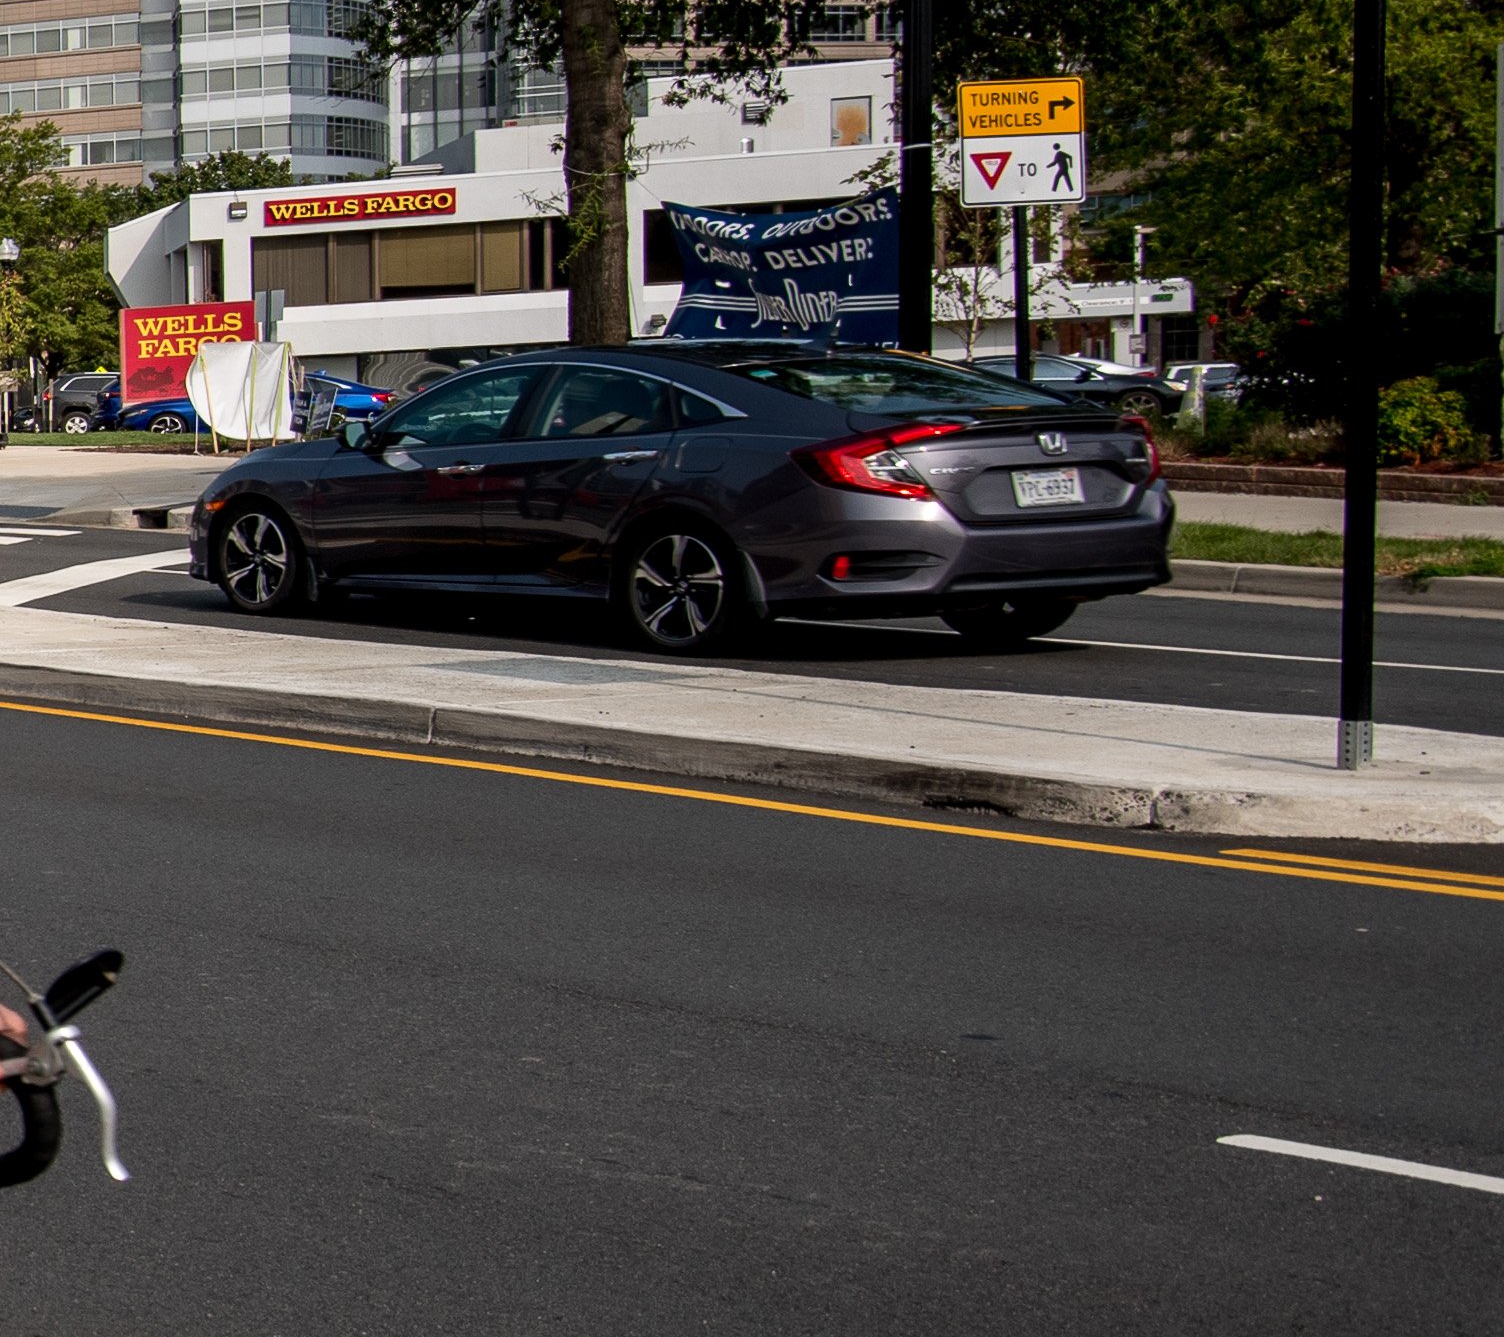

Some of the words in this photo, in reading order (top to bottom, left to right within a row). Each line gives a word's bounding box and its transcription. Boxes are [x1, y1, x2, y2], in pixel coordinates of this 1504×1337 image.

[970, 90, 1039, 107] TURNING
[968, 112, 1042, 129] VEHICLES
[1018, 162, 1037, 177] TO
[269, 198, 359, 221] WELLS
[364, 192, 453, 214] FARGO
[133, 311, 243, 337] WELLS
